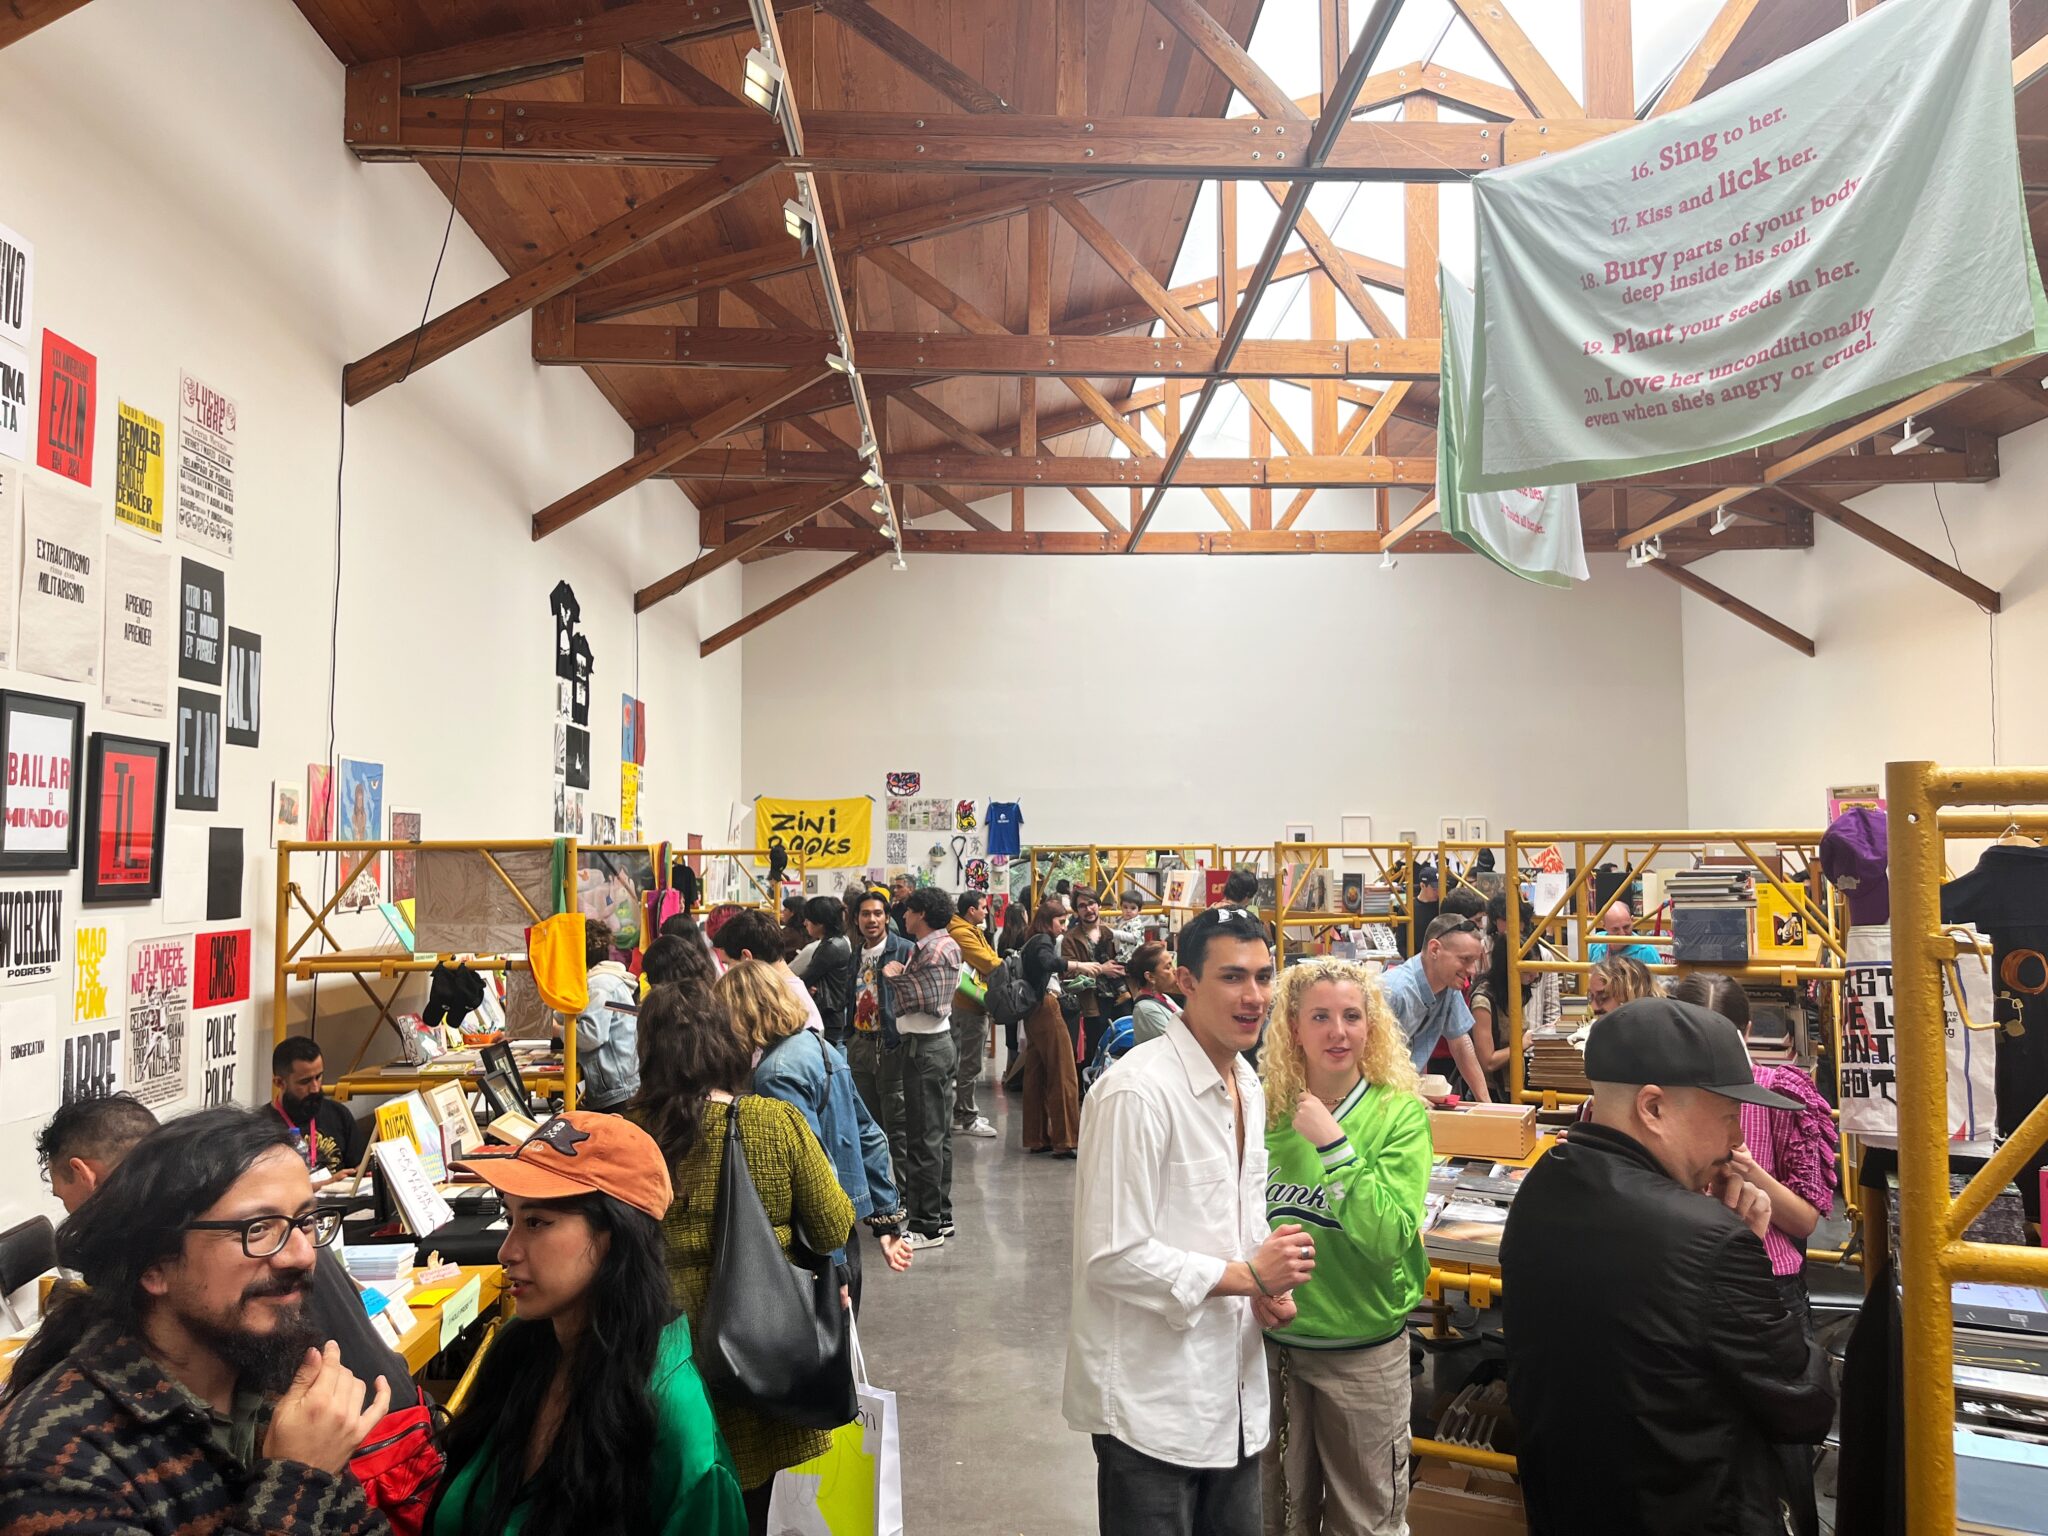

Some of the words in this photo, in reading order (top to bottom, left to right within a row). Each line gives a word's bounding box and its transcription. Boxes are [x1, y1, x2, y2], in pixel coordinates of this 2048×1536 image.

[1631, 161, 1653, 181] 16.
[1659, 133, 1718, 171] Sing
[1723, 127, 1743, 145] to
[1749, 107, 1788, 134] her.
[1611, 216, 1631, 236] 17.
[1636, 205, 1672, 228] Kiss
[1678, 185, 1714, 214] and
[1718, 157, 1772, 199] lick
[1778, 147, 1818, 174] her.
[1581, 272, 1600, 291] 18.
[1604, 252, 1668, 285] Bury
[1673, 238, 1723, 270] parts
[1728, 223, 1750, 246] of
[1754, 206, 1806, 243] your
[1811, 177, 1861, 215] body
[1622, 280, 1665, 304] deep
[1670, 261, 1729, 292] inside
[1734, 246, 1765, 271] his
[1770, 227, 1811, 258] soil.
[1582, 340, 1603, 356] 19.
[1611, 323, 1674, 354] Plant
[1679, 312, 1724, 343] your
[1728, 288, 1783, 323] seeds
[1787, 278, 1811, 298] in
[1815, 259, 1860, 288] her.
[1584, 387, 1603, 404] 20.
[1605, 374, 1665, 401] Love
[1669, 372, 1704, 388] her
[1709, 308, 1875, 381] unconditionally
[1585, 406, 1620, 428] even
[1621, 402, 1668, 423] when
[1672, 390, 1715, 413] she's
[1721, 370, 1783, 402] angry
[1791, 361, 1814, 380] or
[1822, 331, 1877, 370] cruel.
[196, 382, 225, 419] LUCHA
[197, 402, 224, 436] LIBRE
[119, 414, 160, 457] DEMOLER
[117, 485, 152, 515] DEMOLER
[37, 538, 90, 575] EXTRACTIVISMO
[38, 572, 84, 604] MILITARISMO
[125, 593, 153, 618] APRENDER
[124, 623, 152, 647] APRENDER
[8, 752, 71, 791] BAILAR
[178, 707, 217, 799] FIN
[4, 808, 69, 829] MUNDO
[77, 927, 107, 961] MAO
[139, 950, 150, 972] LA
[154, 947, 184, 972] INDEPE
[77, 958, 102, 992] TSE
[131, 973, 144, 995] NO
[161, 967, 187, 989] VENDE
[74, 986, 108, 1022] PUNK
[206, 1013, 236, 1060] POLICE
[205, 1063, 236, 1109] POLICE
[1266, 1166, 1332, 1211] ank
